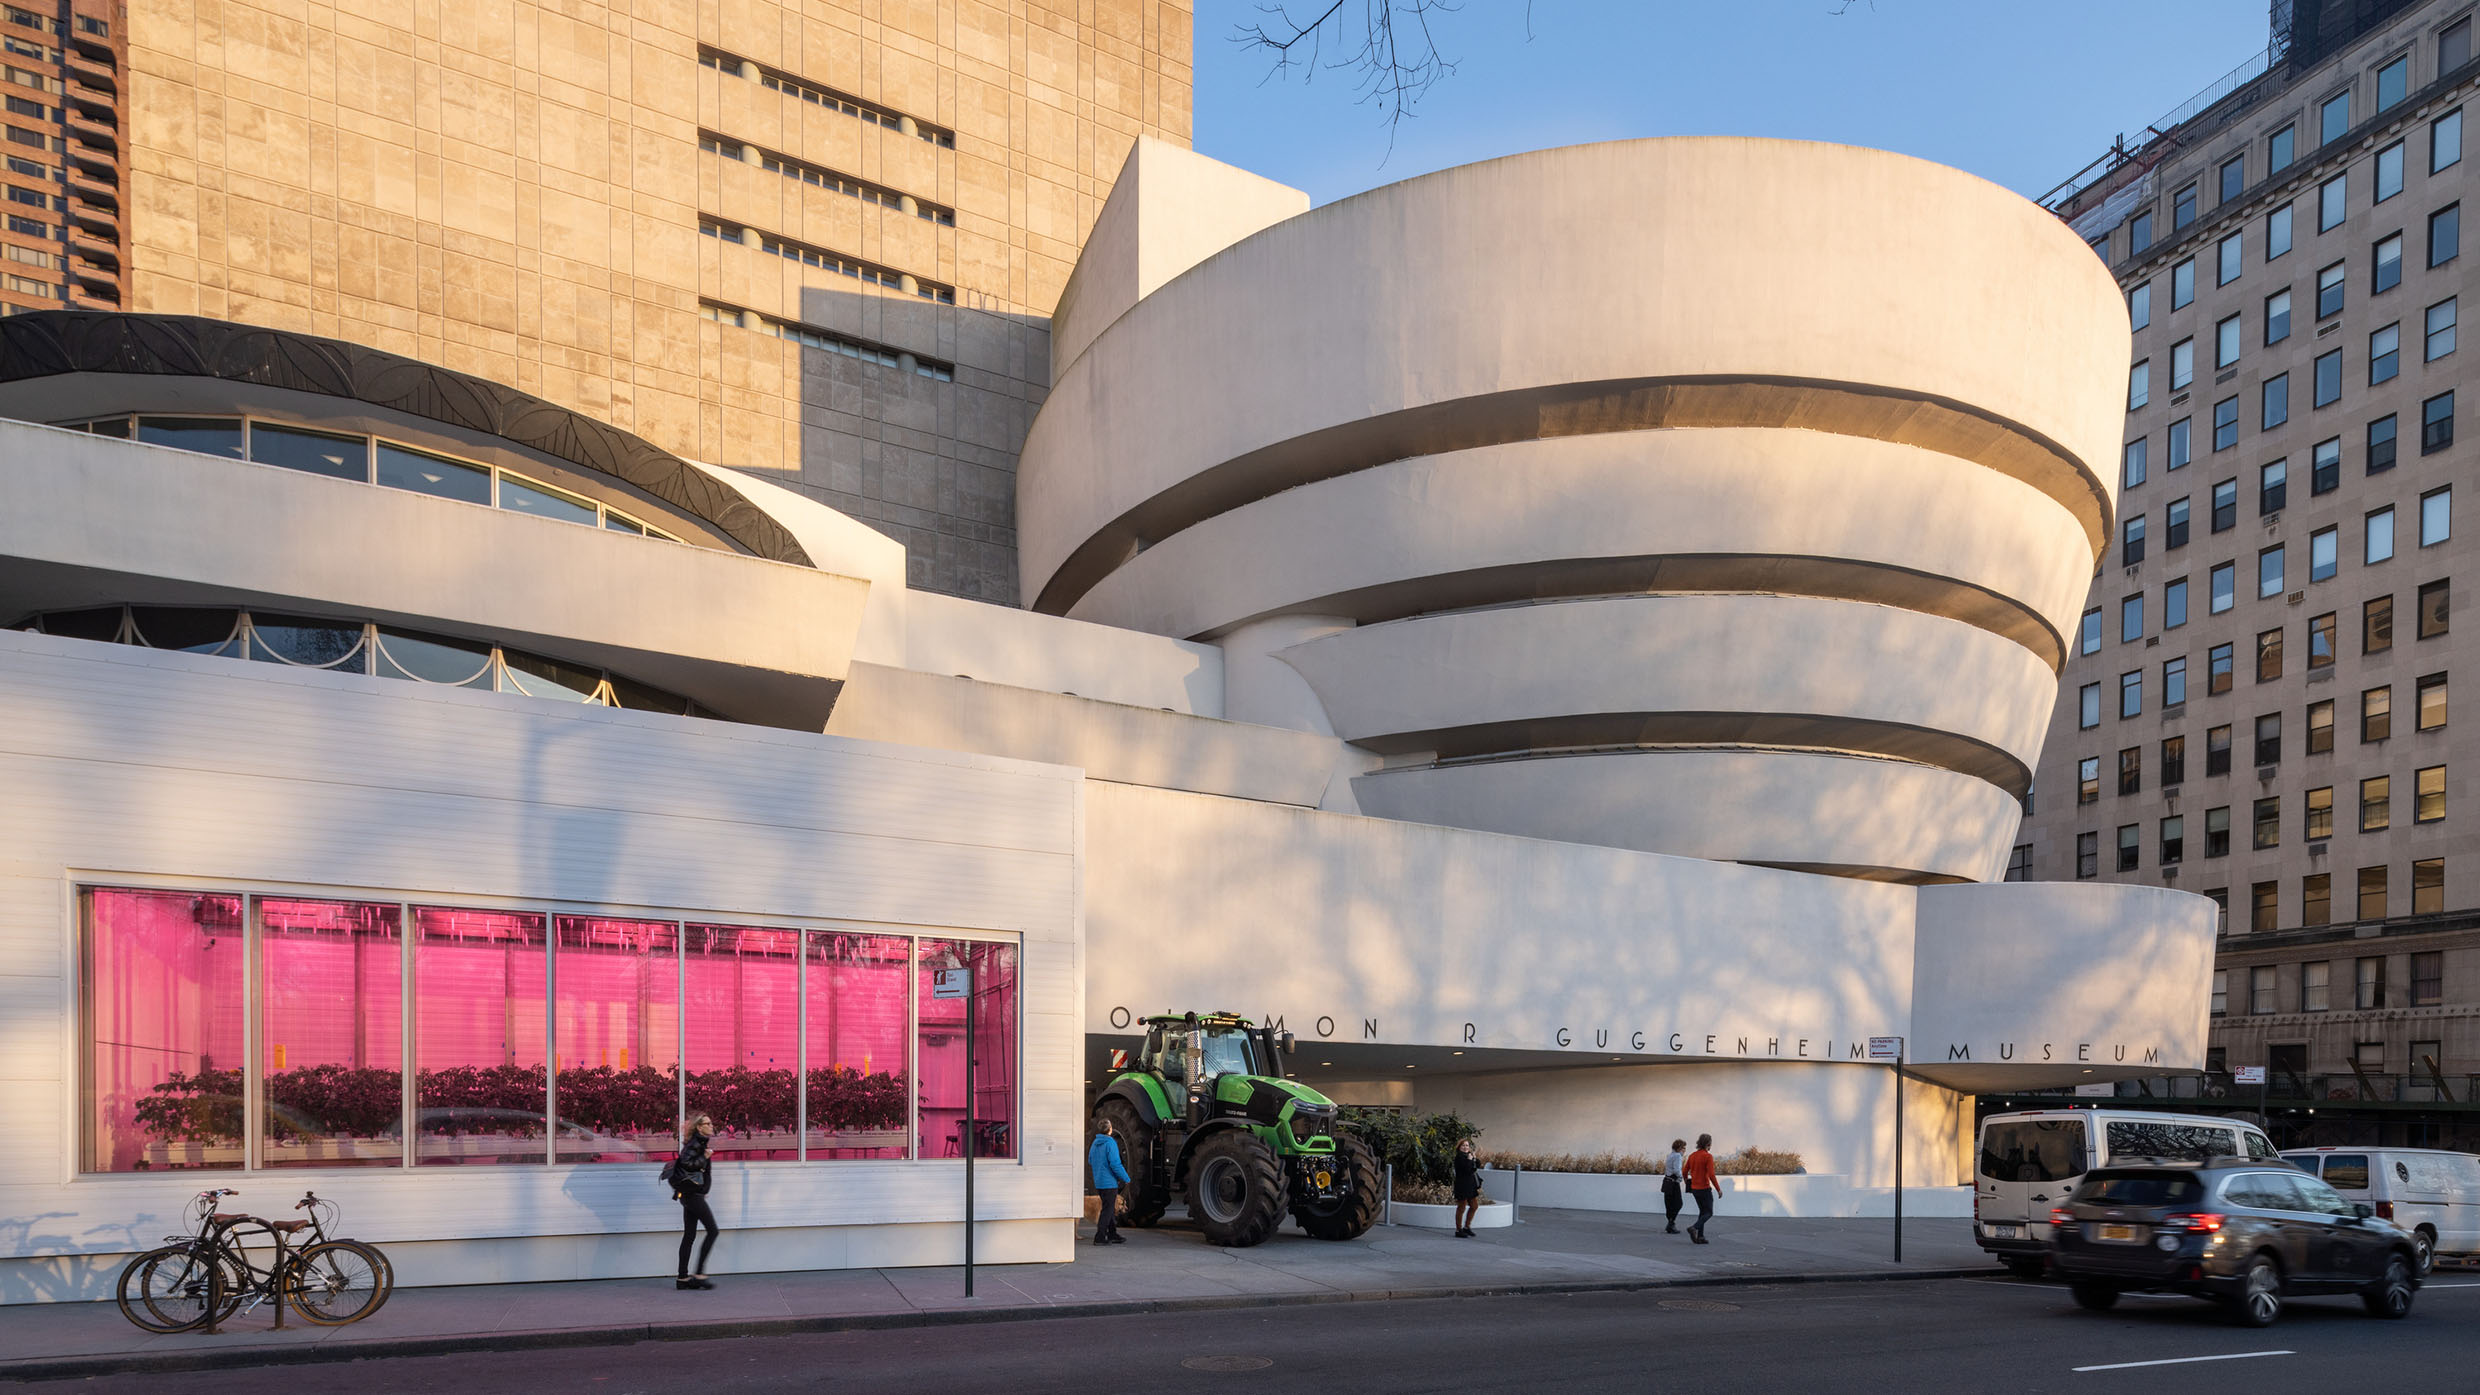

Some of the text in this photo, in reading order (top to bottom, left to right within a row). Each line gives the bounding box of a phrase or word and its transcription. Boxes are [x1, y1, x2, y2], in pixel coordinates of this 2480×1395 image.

[1463, 1022, 1476, 1044] R
[1556, 1027, 1865, 1059] GUGGENHEIM
[1948, 1043, 2158, 1064] MUSEUM
